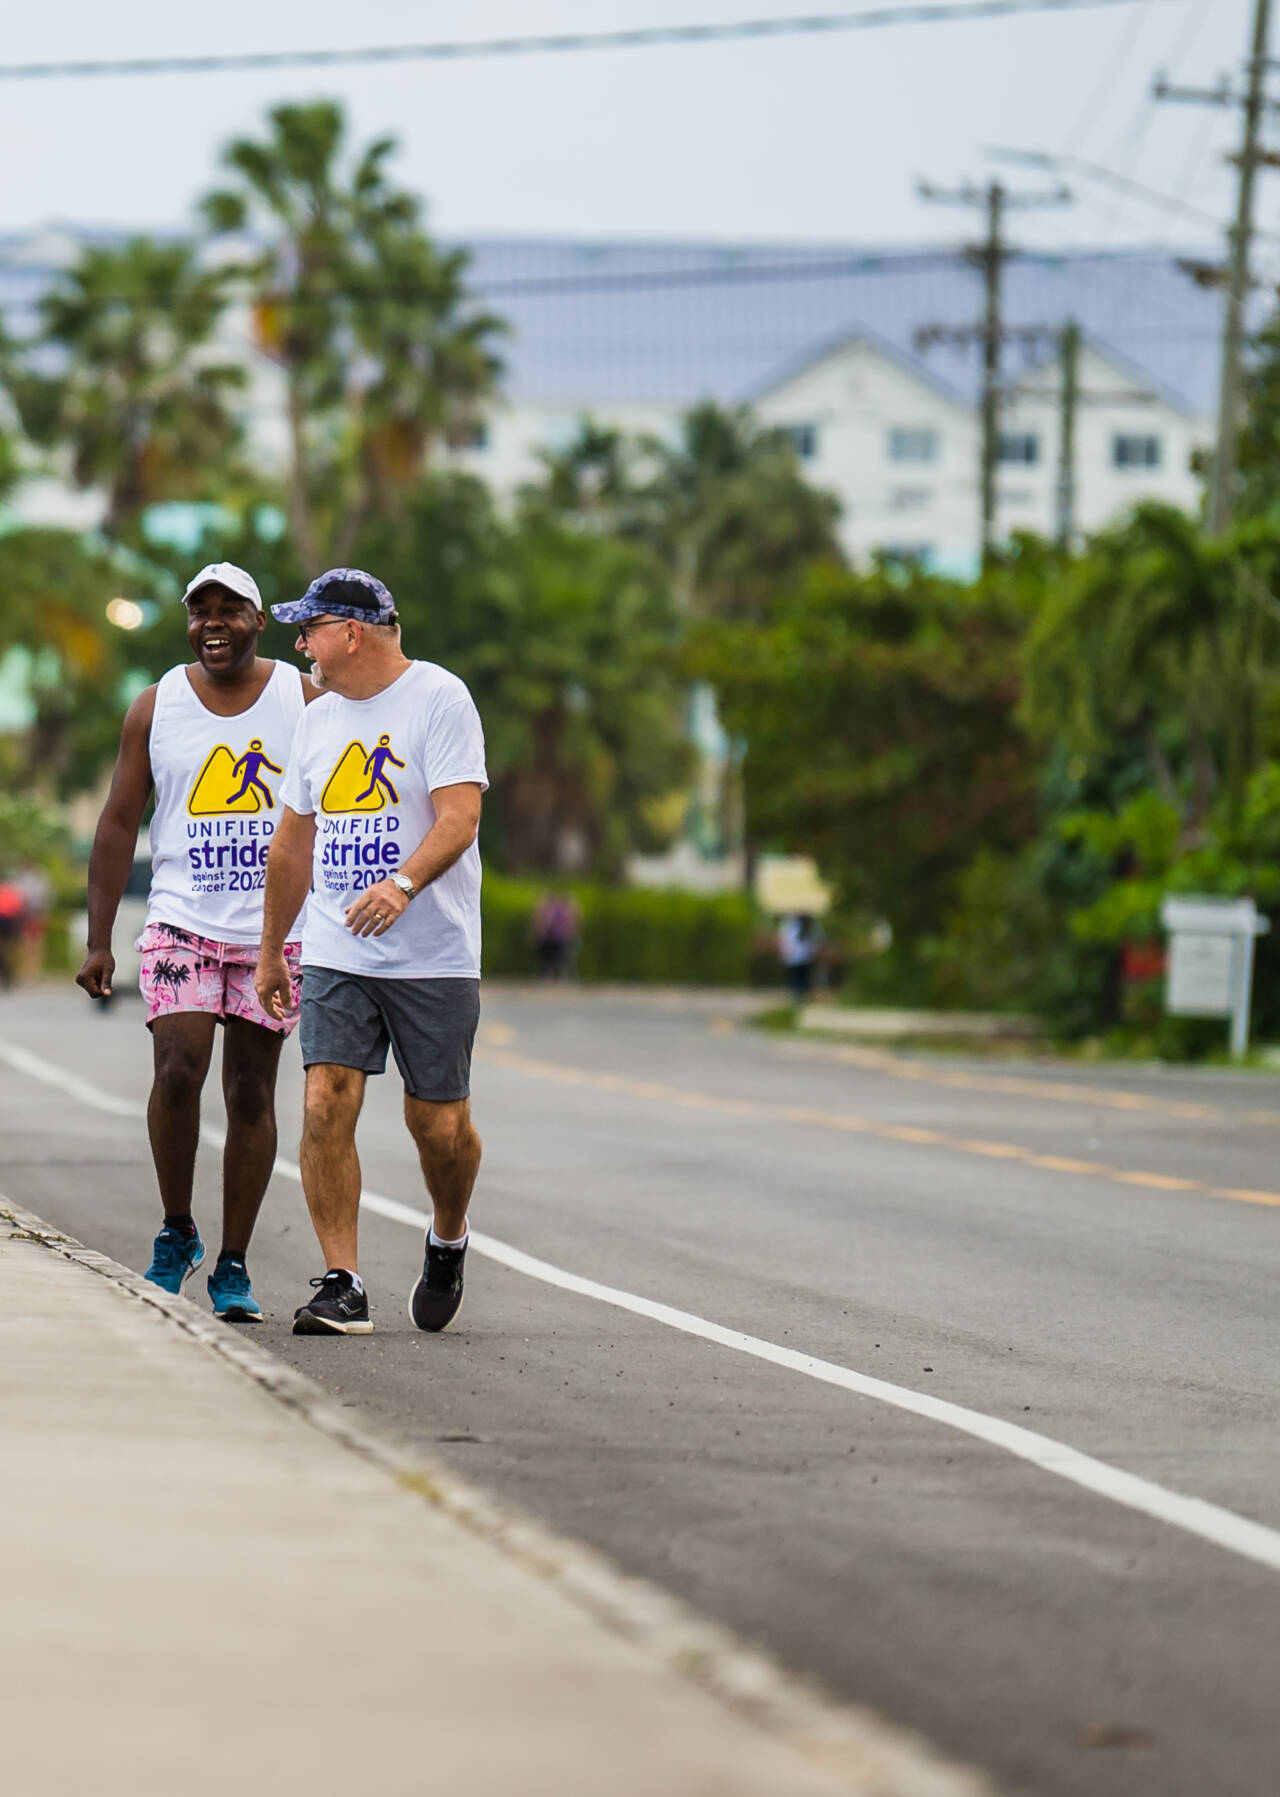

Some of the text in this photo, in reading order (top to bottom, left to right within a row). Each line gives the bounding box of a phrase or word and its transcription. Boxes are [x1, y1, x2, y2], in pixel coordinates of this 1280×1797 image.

[187, 820, 274, 839] UNIFIED
[323, 816, 400, 835] UNIFIED
[188, 837, 270, 870] stride
[321, 835, 401, 867] stride
[228, 869, 267, 892] 2022
[323, 868, 348, 880] gainst
[351, 867, 400, 891] 202
